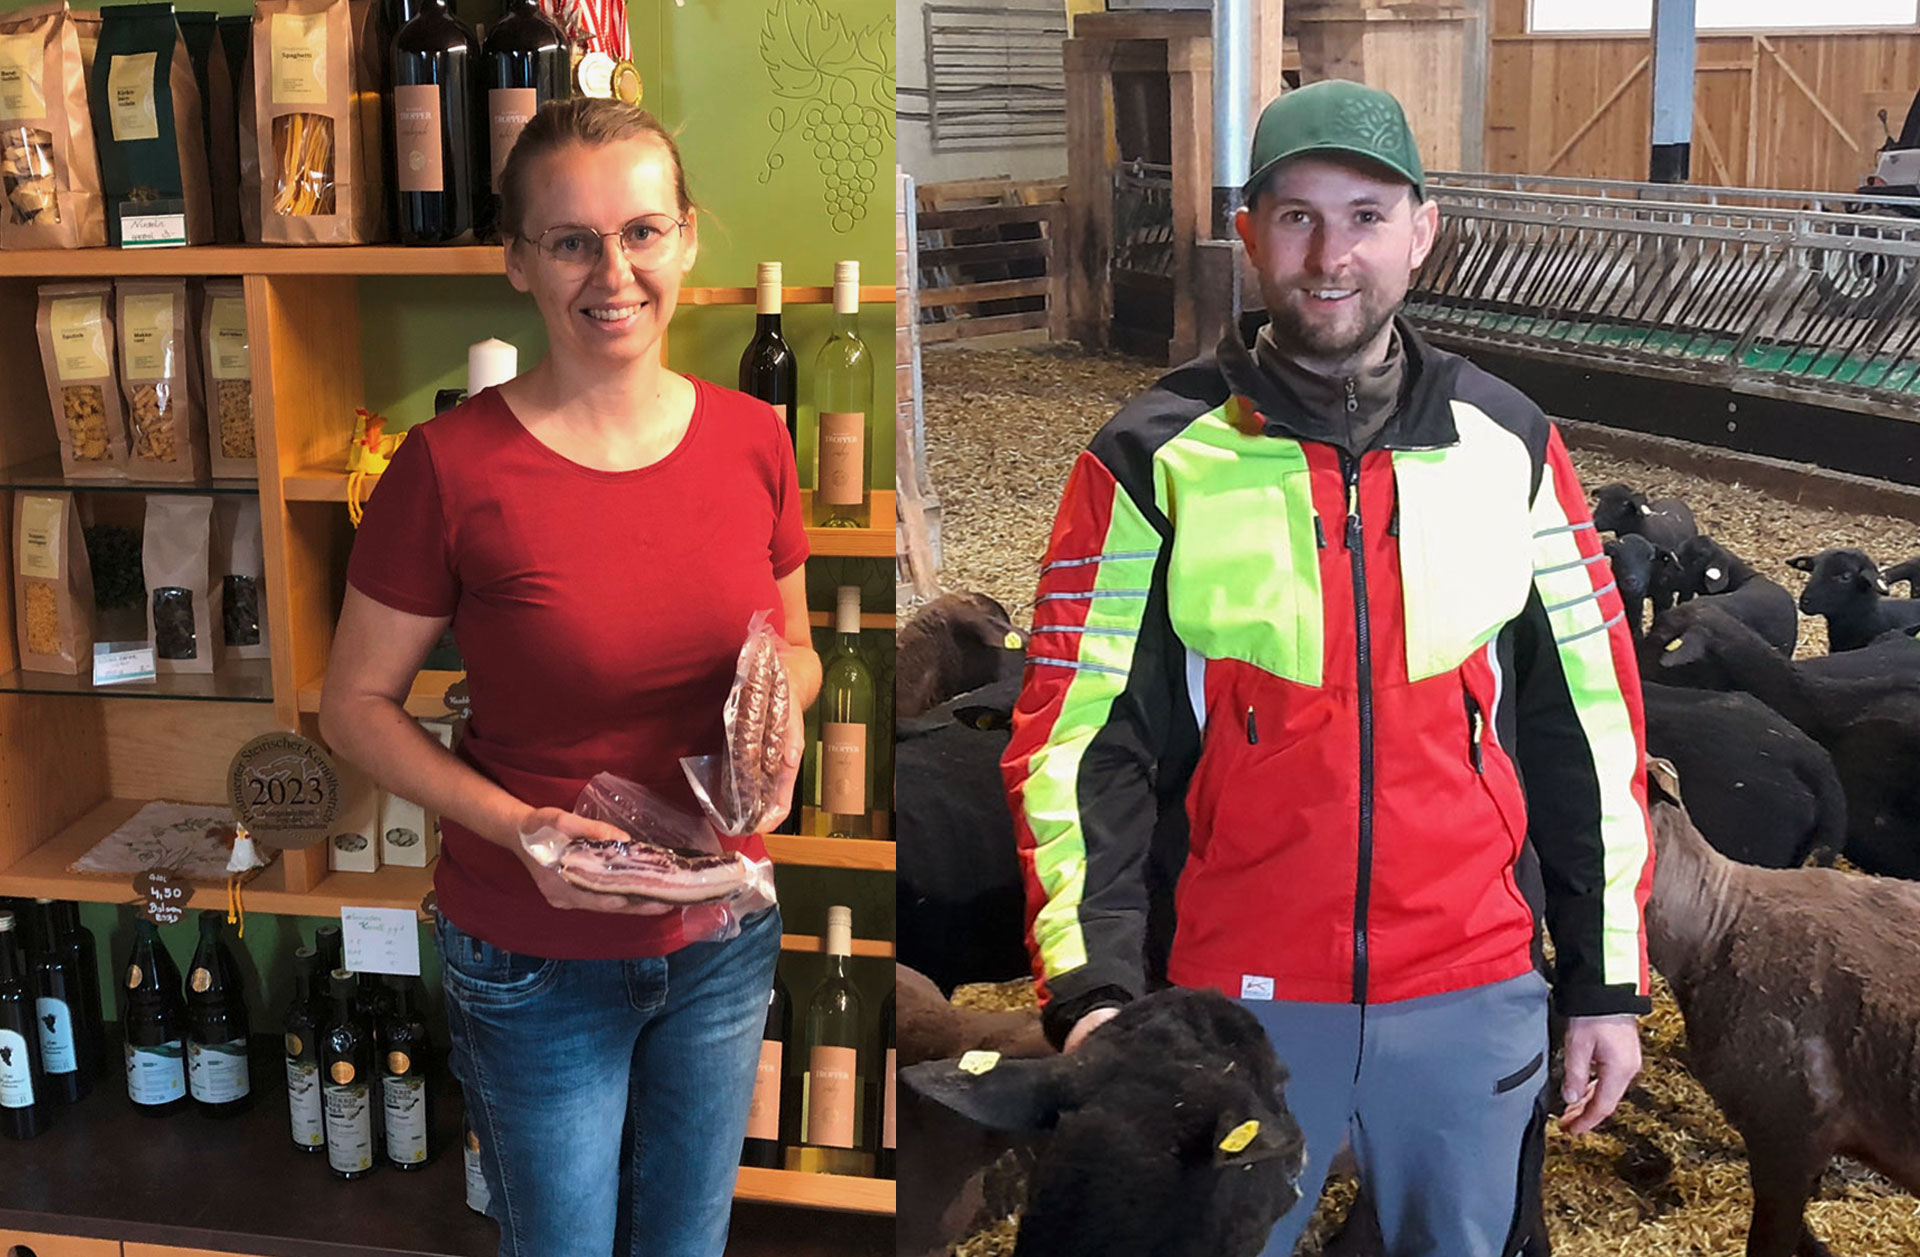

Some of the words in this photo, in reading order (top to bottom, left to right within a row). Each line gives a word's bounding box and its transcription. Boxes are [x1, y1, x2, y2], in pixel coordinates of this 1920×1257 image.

[241, 738, 303, 761] Steirischer
[248, 777, 323, 806] 2023
[151, 886, 182, 900] 4,50
[816, 1070, 849, 1079] TROPPER
